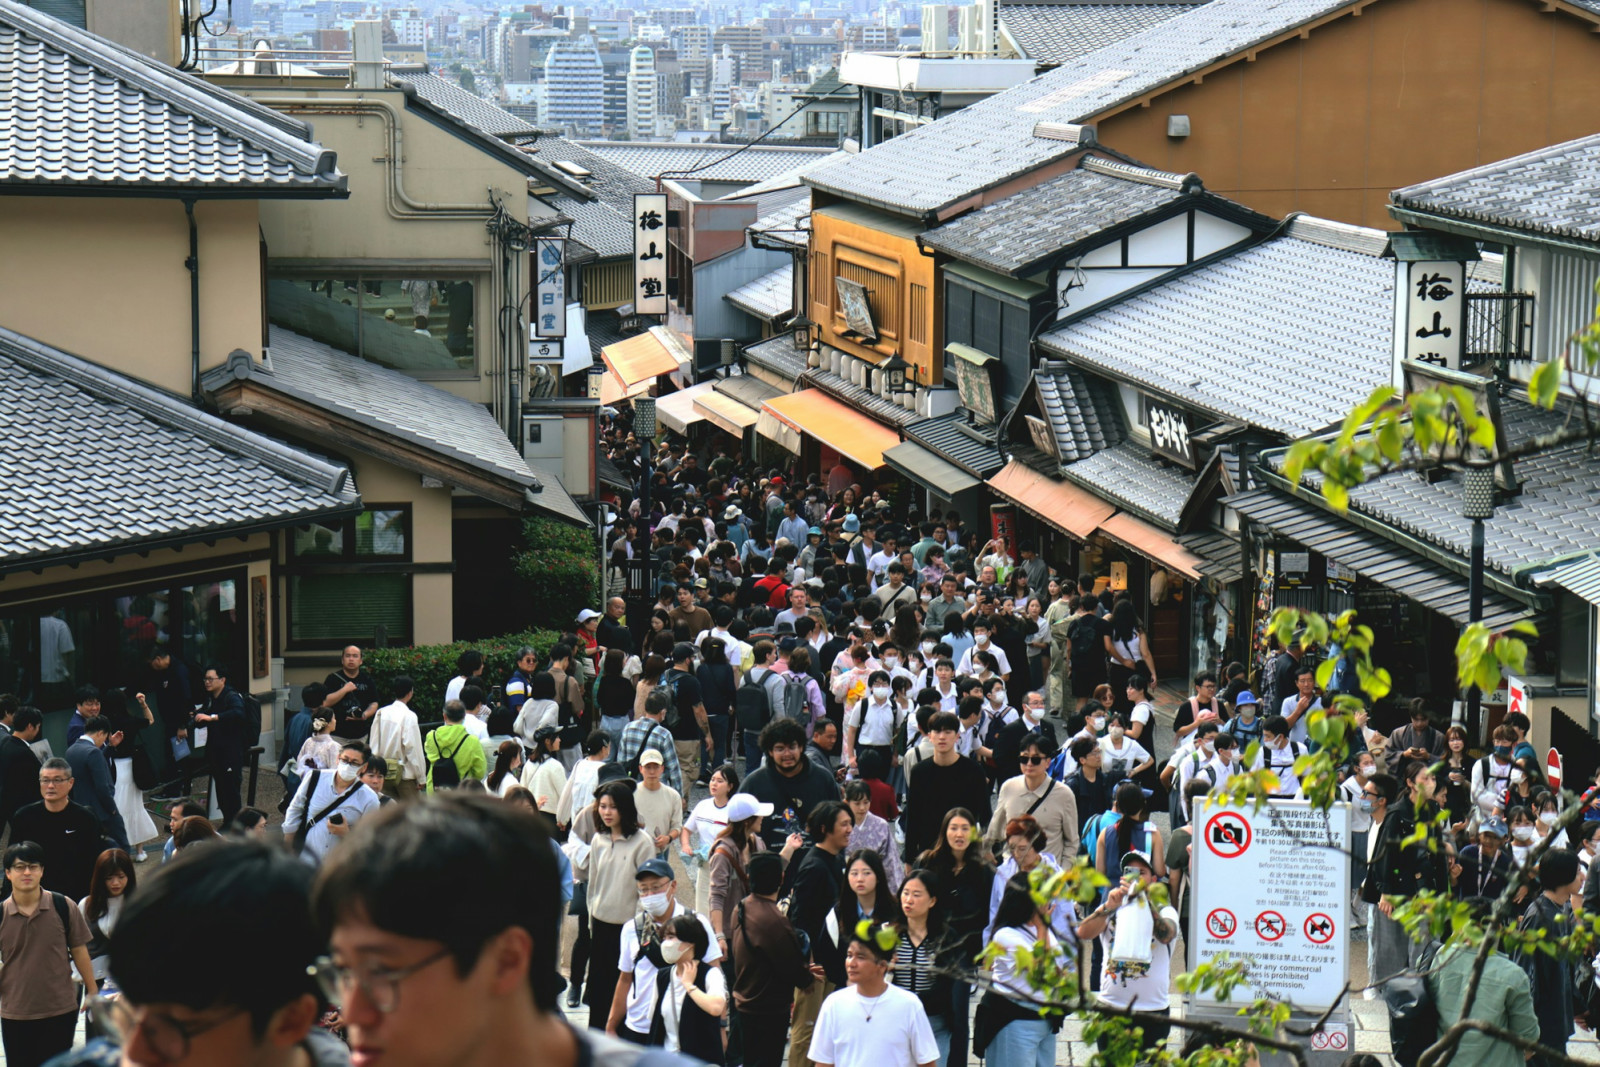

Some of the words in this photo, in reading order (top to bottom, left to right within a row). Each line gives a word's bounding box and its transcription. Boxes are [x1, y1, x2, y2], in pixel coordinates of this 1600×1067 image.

[639, 210, 665, 299] 梅山堂
[541, 269, 556, 330] 朝日堂
[1218, 960, 1251, 970] Shong
[1264, 964, 1277, 972] any
[1280, 963, 1322, 973] commercial
[1271, 971, 1309, 981] prohibited
